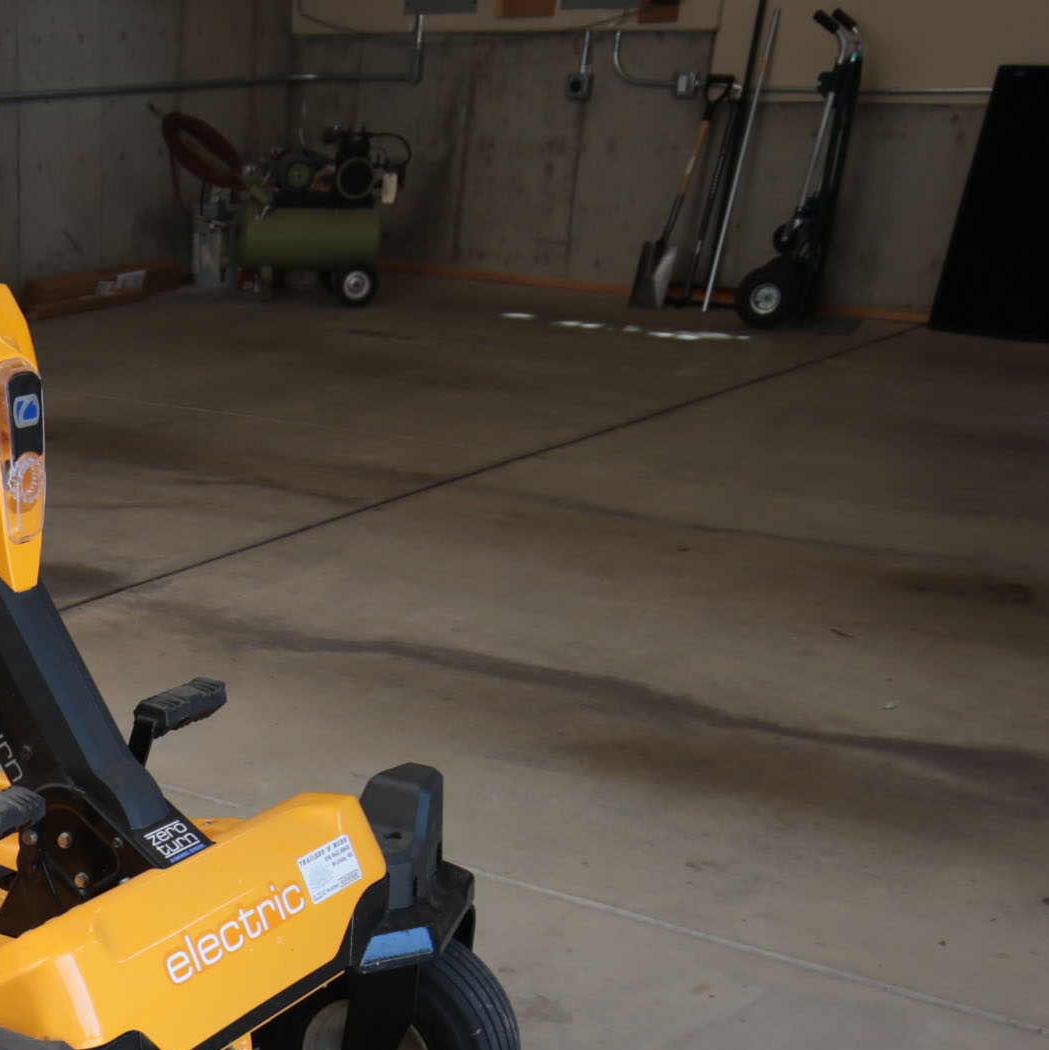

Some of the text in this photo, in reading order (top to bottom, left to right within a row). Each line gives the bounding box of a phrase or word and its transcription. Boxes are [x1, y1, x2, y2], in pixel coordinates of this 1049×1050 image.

[146, 823, 187, 847] zero
[156, 832, 199, 856] turn
[166, 884, 306, 984] electric
